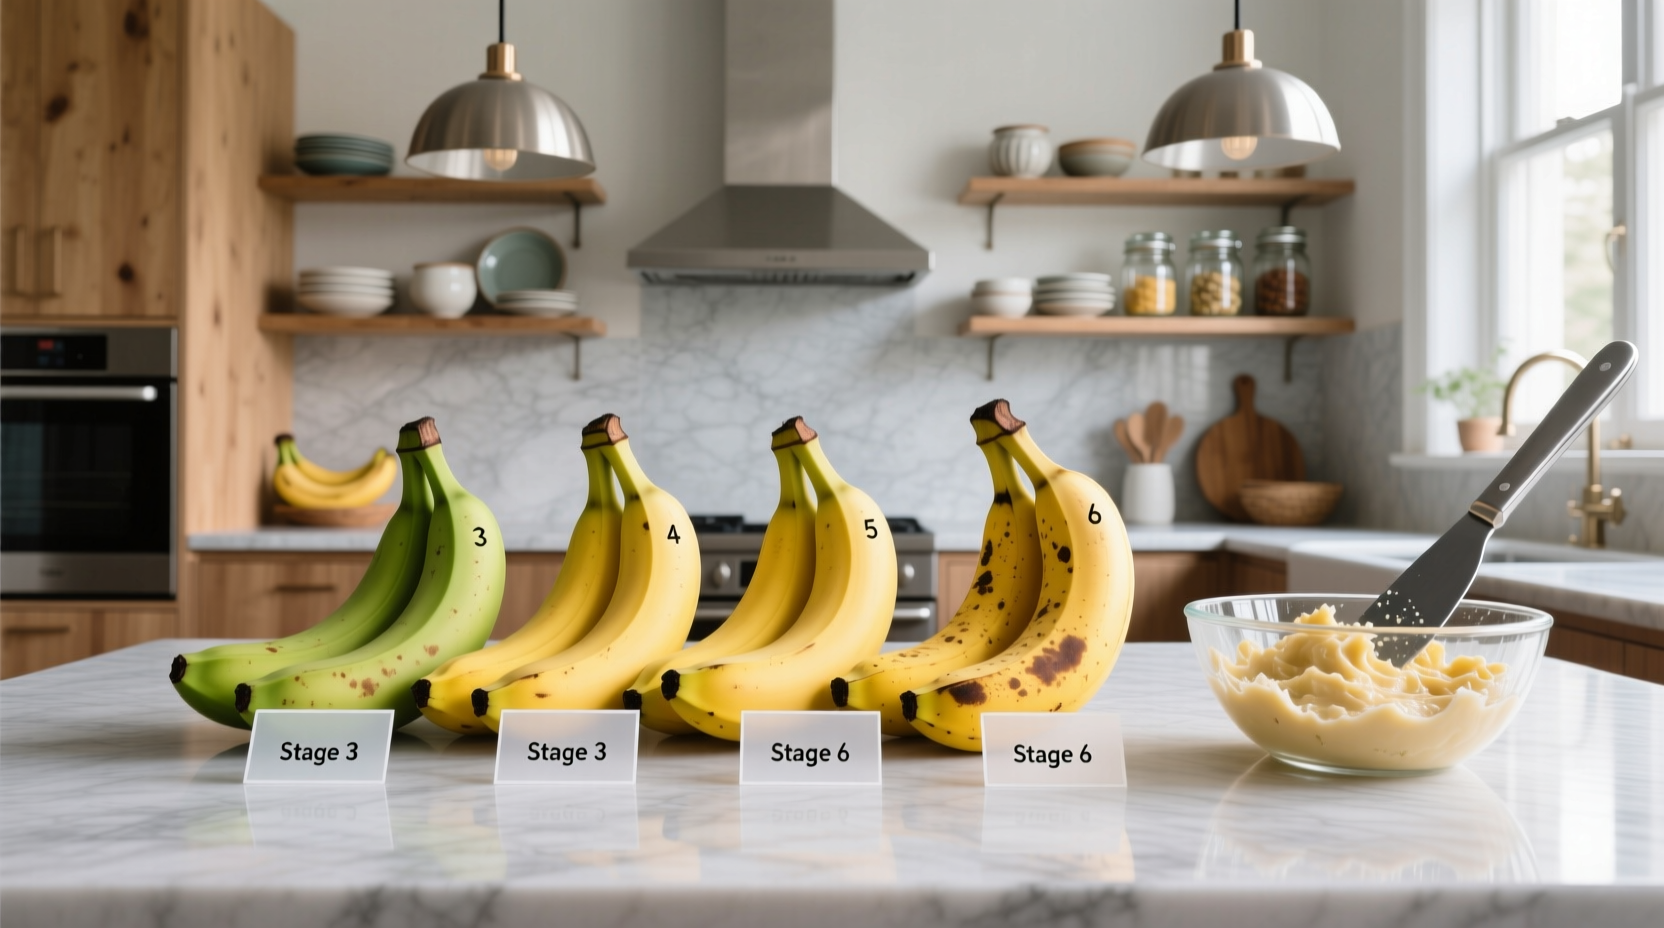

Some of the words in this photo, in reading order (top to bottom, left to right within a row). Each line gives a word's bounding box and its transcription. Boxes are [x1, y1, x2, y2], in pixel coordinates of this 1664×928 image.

[1087, 503, 1103, 525] 6
[472, 526, 487, 548] 3
[666, 524, 682, 545] 4
[864, 518, 879, 540] 5
[279, 741, 340, 766] Stage
[345, 741, 359, 761] 3
[527, 741, 588, 767] Stage
[594, 741, 608, 761] 3
[771, 742, 832, 768] Stage
[837, 742, 850, 762] 6
[1013, 744, 1074, 769] Stage
[1079, 744, 1093, 764] 6
